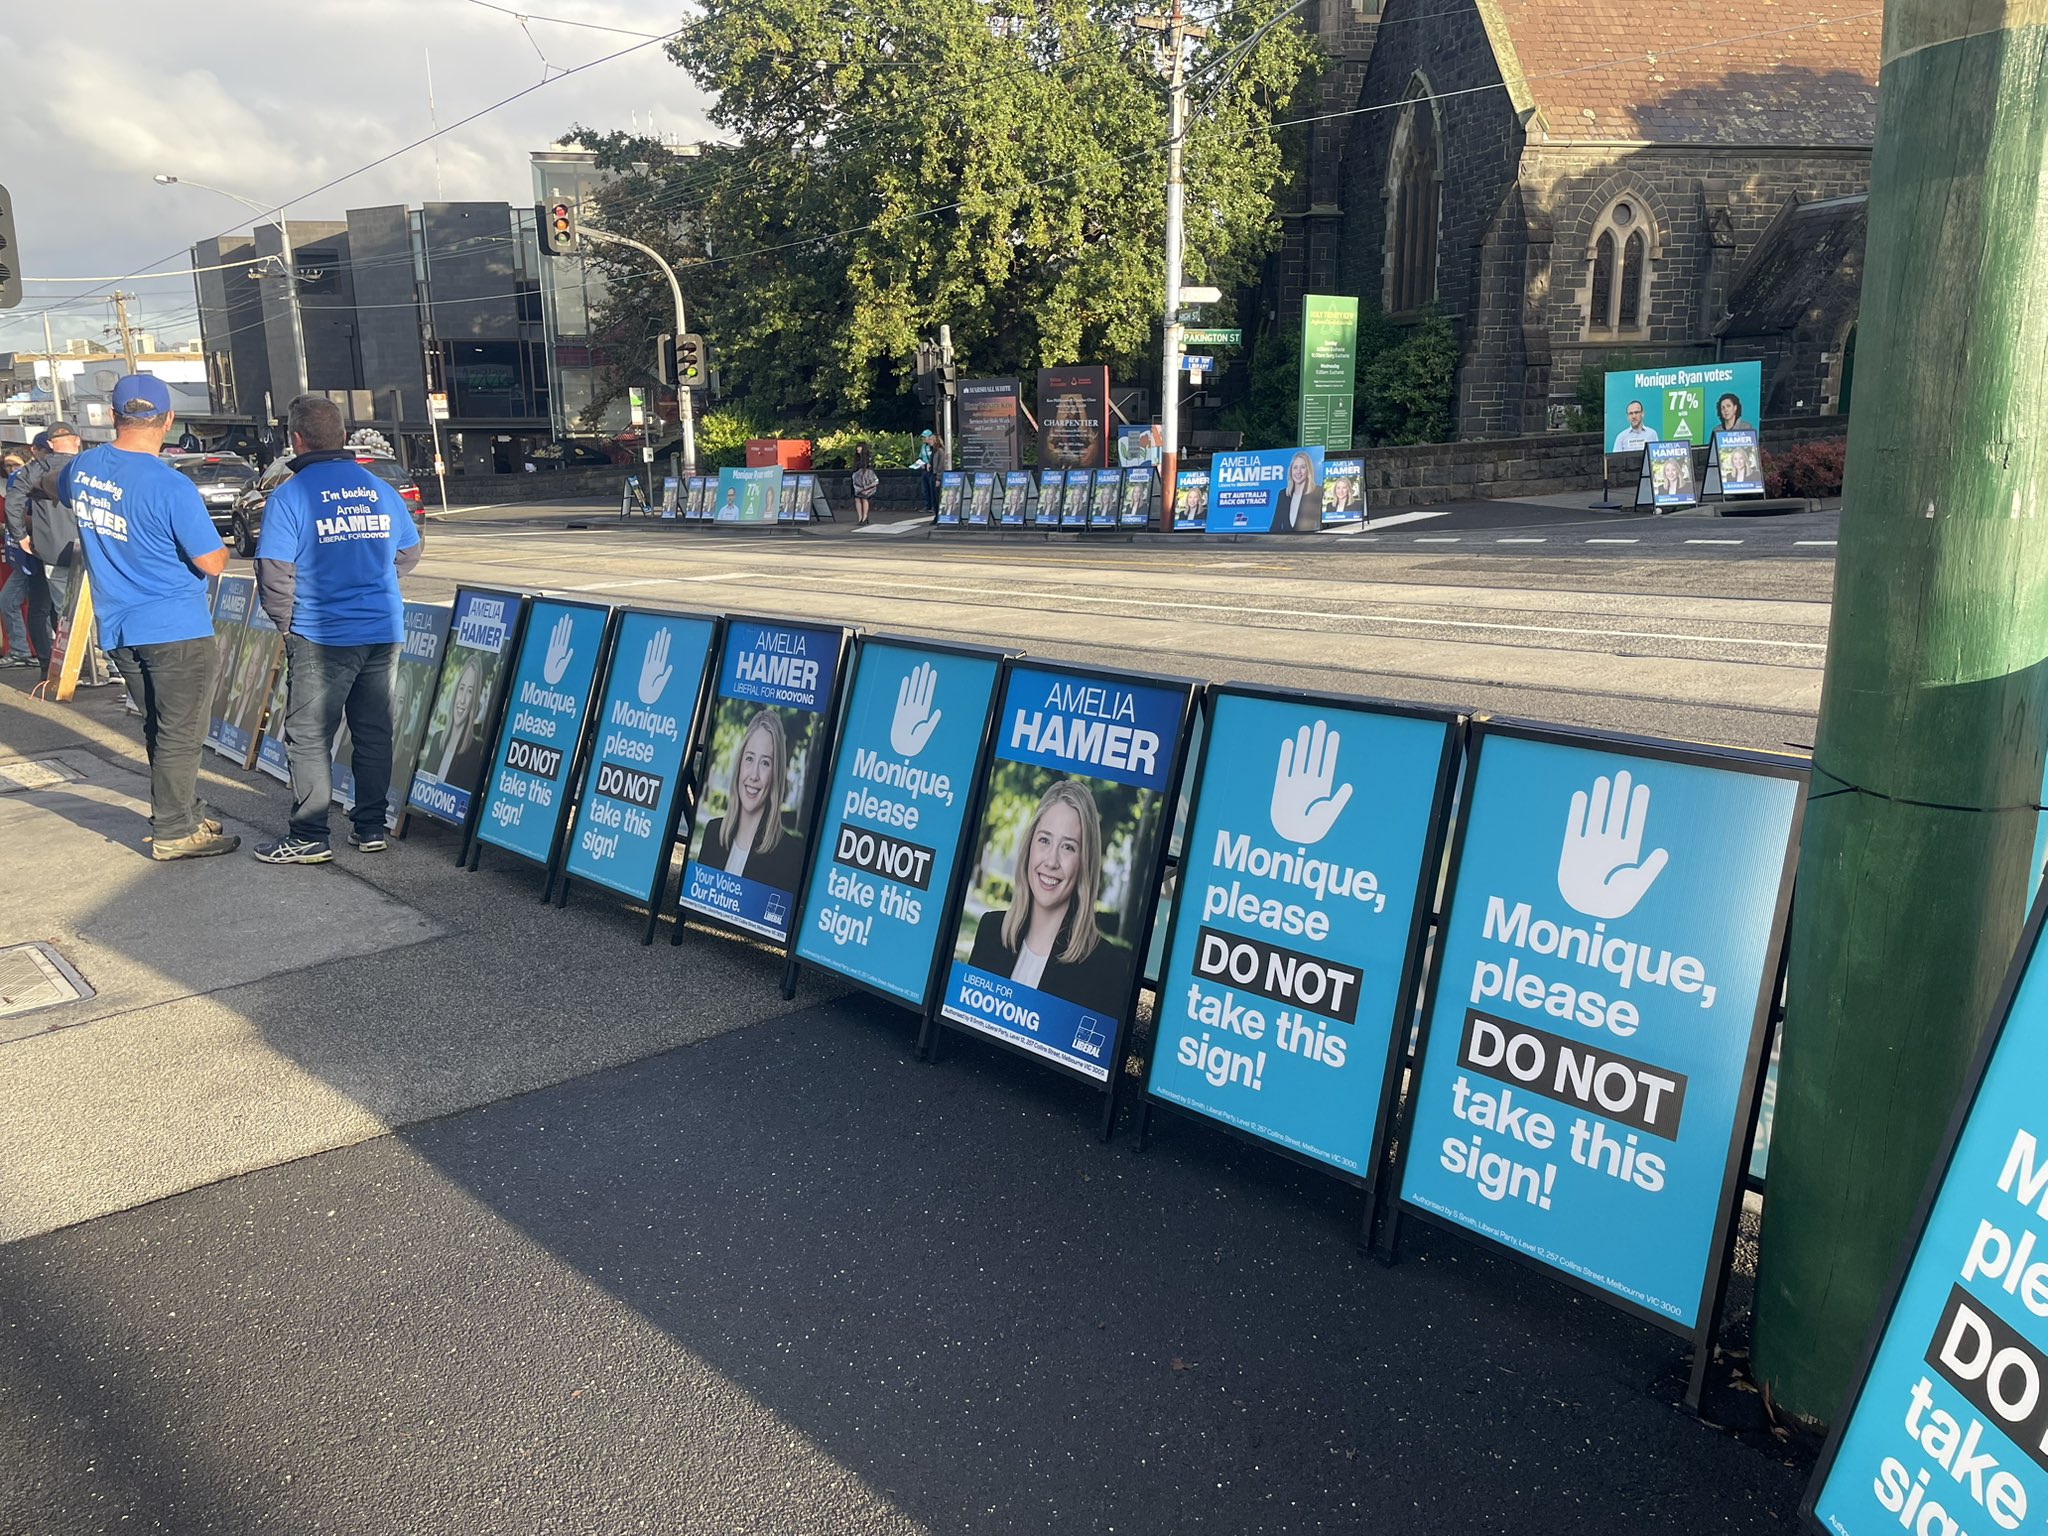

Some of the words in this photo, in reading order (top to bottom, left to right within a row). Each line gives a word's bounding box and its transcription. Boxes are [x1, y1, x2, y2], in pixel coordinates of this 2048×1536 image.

[1192, 311, 1199, 320] ST
[1183, 334, 1228, 342] PAKINGTON
[1229, 333, 1240, 342] ST
[1635, 372, 1677, 389] Monique
[1678, 370, 1703, 387] Ryan
[1704, 369, 1733, 383] votes:
[1668, 390, 1699, 411] 77%
[1043, 419, 1099, 427] CHARPENTIER
[1652, 448, 1687, 457] HAMER
[1722, 436, 1752, 444] HAMER
[1218, 465, 1284, 483] HAMER
[1220, 455, 1261, 467] AMELIA
[1325, 465, 1361, 475] HAMER
[74, 471, 91, 486] I'm
[90, 476, 123, 501] backing
[321, 490, 341, 503] I'm
[341, 486, 379, 503] backing
[1179, 477, 1210, 486] HAMER
[1232, 491, 1267, 499] AUSTRALIA
[336, 504, 371, 516] Amelia
[1219, 498, 1236, 506] BACK
[315, 514, 391, 536] HAMER
[319, 535, 347, 544] LIBERAL
[220, 593, 246, 613] HAMER
[470, 601, 501, 620] AMELIA
[404, 611, 433, 631] AMELIA
[460, 621, 502, 648] HAMER
[400, 629, 438, 659] MER
[755, 631, 806, 657] AMELIA
[735, 651, 819, 691] HAMER
[520, 681, 577, 719] Monique,
[734, 683, 759, 697] LIBERAL
[760, 687, 776, 698] FOR
[775, 689, 814, 705] KOOYONG
[1044, 682, 1135, 723] AMELIA
[512, 709, 556, 738] please
[611, 700, 679, 743] Monique,
[602, 732, 654, 764] please
[1010, 708, 1160, 776] HAMER
[508, 741, 529, 768] DO
[529, 749, 560, 776] NOT
[499, 771, 527, 798] take
[528, 779, 553, 807] this
[598, 766, 623, 792] DO
[623, 774, 660, 805] NOT
[852, 748, 954, 807] Monique,
[410, 780, 457, 815] KOOYONG
[491, 798, 524, 827] sign!
[842, 787, 919, 830] please
[589, 798, 621, 828] take
[623, 808, 652, 839] this
[582, 828, 619, 860] sign!
[837, 829, 874, 866] DO
[876, 839, 931, 883] NOT
[695, 866, 715, 886] Your
[716, 873, 743, 896] Voice.
[1212, 829, 1386, 914] Monique,
[690, 882, 708, 900] Our
[708, 888, 740, 913] Future.
[827, 868, 874, 908] take
[880, 884, 922, 925] this
[1202, 881, 1330, 942] please
[818, 904, 873, 946] sign!
[1482, 895, 1717, 1009] Monique,
[963, 973, 995, 994] LIBERAL
[995, 984, 1013, 999] FOR
[1200, 934, 1259, 984] DO
[1264, 951, 1355, 1012] NOT
[959, 986, 1040, 1032] KOOYONG
[1470, 957, 1640, 1037] please
[1187, 983, 1266, 1041] take
[1276, 1011, 1347, 1069] this
[1034, 1042, 1048, 1053] Collins
[1072, 1038, 1100, 1059] LIBERAL
[1177, 1032, 1267, 1092] sign!
[1467, 1018, 1546, 1082] DO
[1552, 1046, 1676, 1125] NOT
[1206, 1105, 1223, 1116] Liberal
[1237, 1117, 1250, 1127] Level
[1257, 1124, 1267, 1134] 257
[1267, 1128, 1284, 1141] Collins
[1302, 1141, 1331, 1159] Melbourne
[1331, 1152, 1341, 1163] VIC
[1451, 1075, 1556, 1150] take
[1569, 1117, 1666, 1193] this
[1440, 1135, 1558, 1212] sign!
[1412, 1192, 1445, 1212] Authorised
[1444, 1206, 1454, 1217] by
[1453, 1210, 1459, 1219] S
[1458, 1212, 1477, 1228] Smith,
[1478, 1221, 1500, 1236] Liberal
[1499, 1230, 1518, 1246] Party,
[1518, 1239, 1536, 1253] Level
[1537, 1247, 1546, 1258] 12,
[1546, 1250, 1559, 1262] 257
[1559, 1256, 1582, 1273] Collins
[1583, 1266, 1606, 1284] Street,
[1606, 1277, 1645, 1301] Melbourne
[1646, 1294, 1660, 1307] VIC
[1960, 1218, 2048, 1317] ple
[1939, 1303, 2040, 1422] DO
[1904, 1376, 2028, 1531] take
